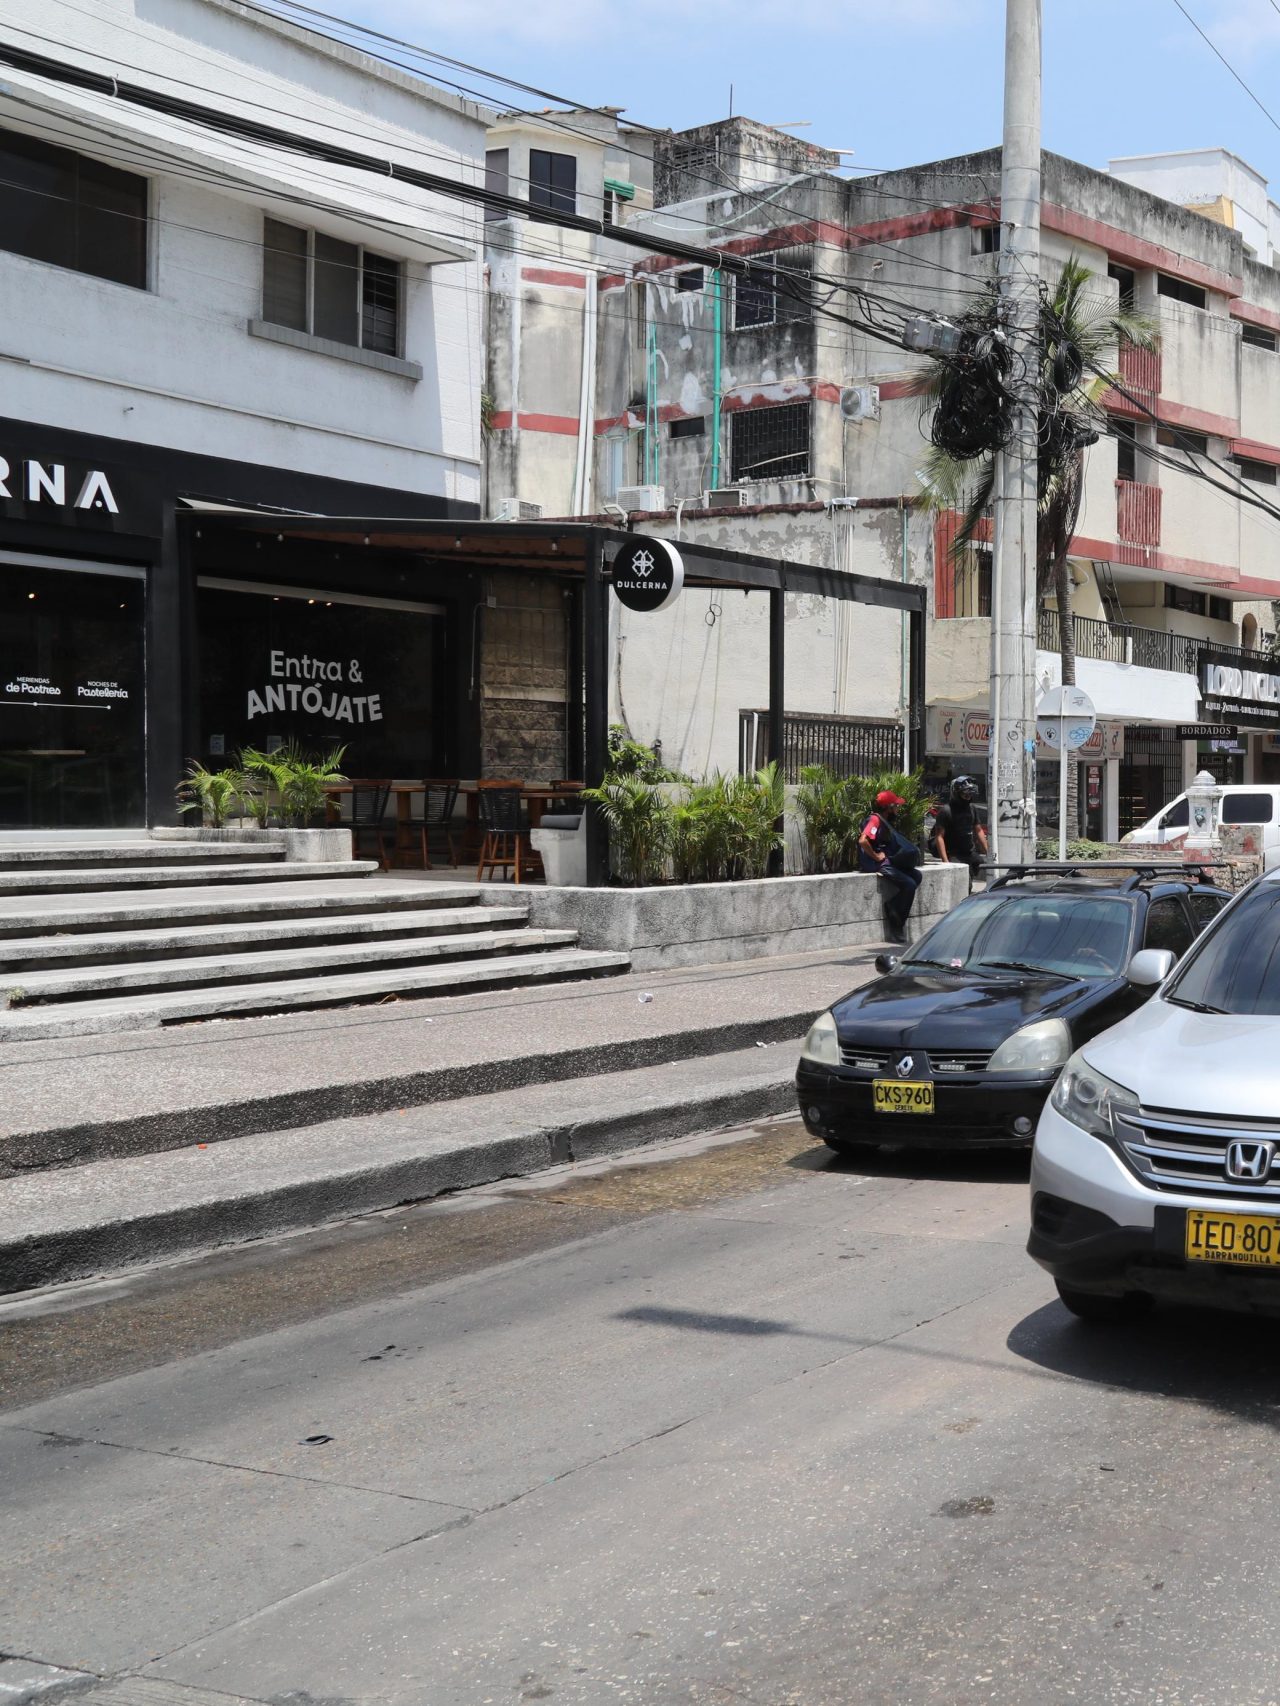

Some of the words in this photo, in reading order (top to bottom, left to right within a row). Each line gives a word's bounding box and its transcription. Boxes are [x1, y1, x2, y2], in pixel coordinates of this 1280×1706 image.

[617, 581, 667, 590] DULCERNA
[271, 650, 343, 682] Entra
[348, 659, 363, 683] &
[16, 676, 50, 684] MERIENDAS
[87, 680, 110, 688] NOCHES
[5, 682, 20, 693] de
[21, 682, 61, 695] Postres
[77, 686, 128, 699] Pastelería
[247, 682, 384, 723] ANTÓJATE
[1181, 726, 1231, 735] BORDADOS
[1204, 1249, 1271, 1264] BARRANQUILLA
